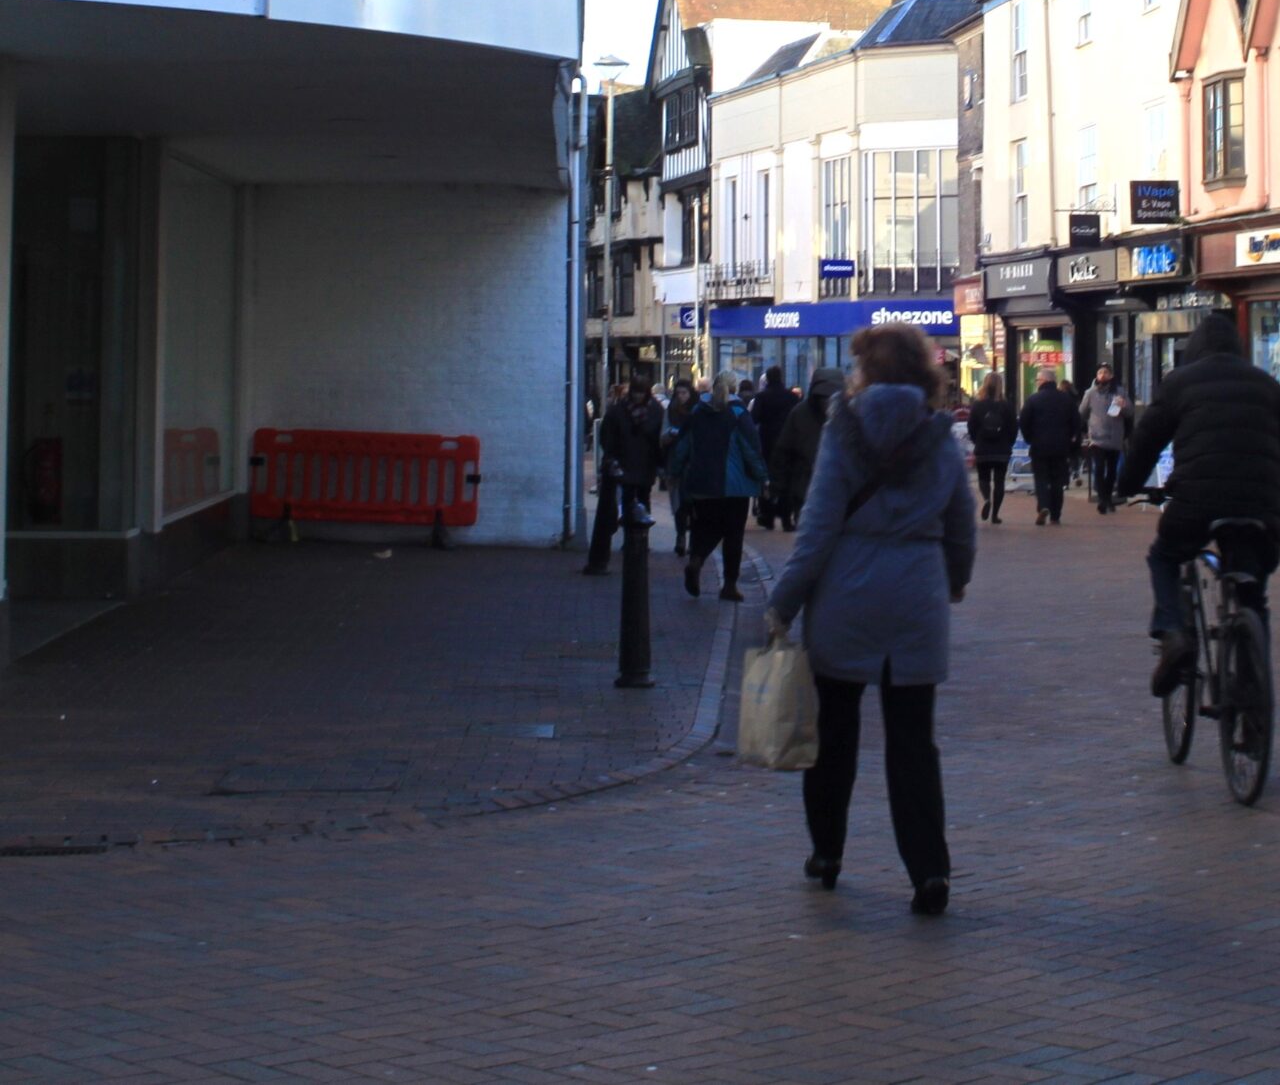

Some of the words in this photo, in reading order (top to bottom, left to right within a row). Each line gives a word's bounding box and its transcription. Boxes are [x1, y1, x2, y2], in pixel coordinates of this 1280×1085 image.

[823, 264, 853, 272] shoezone
[764, 306, 800, 329] shoezone
[871, 306, 953, 325] shoezone
